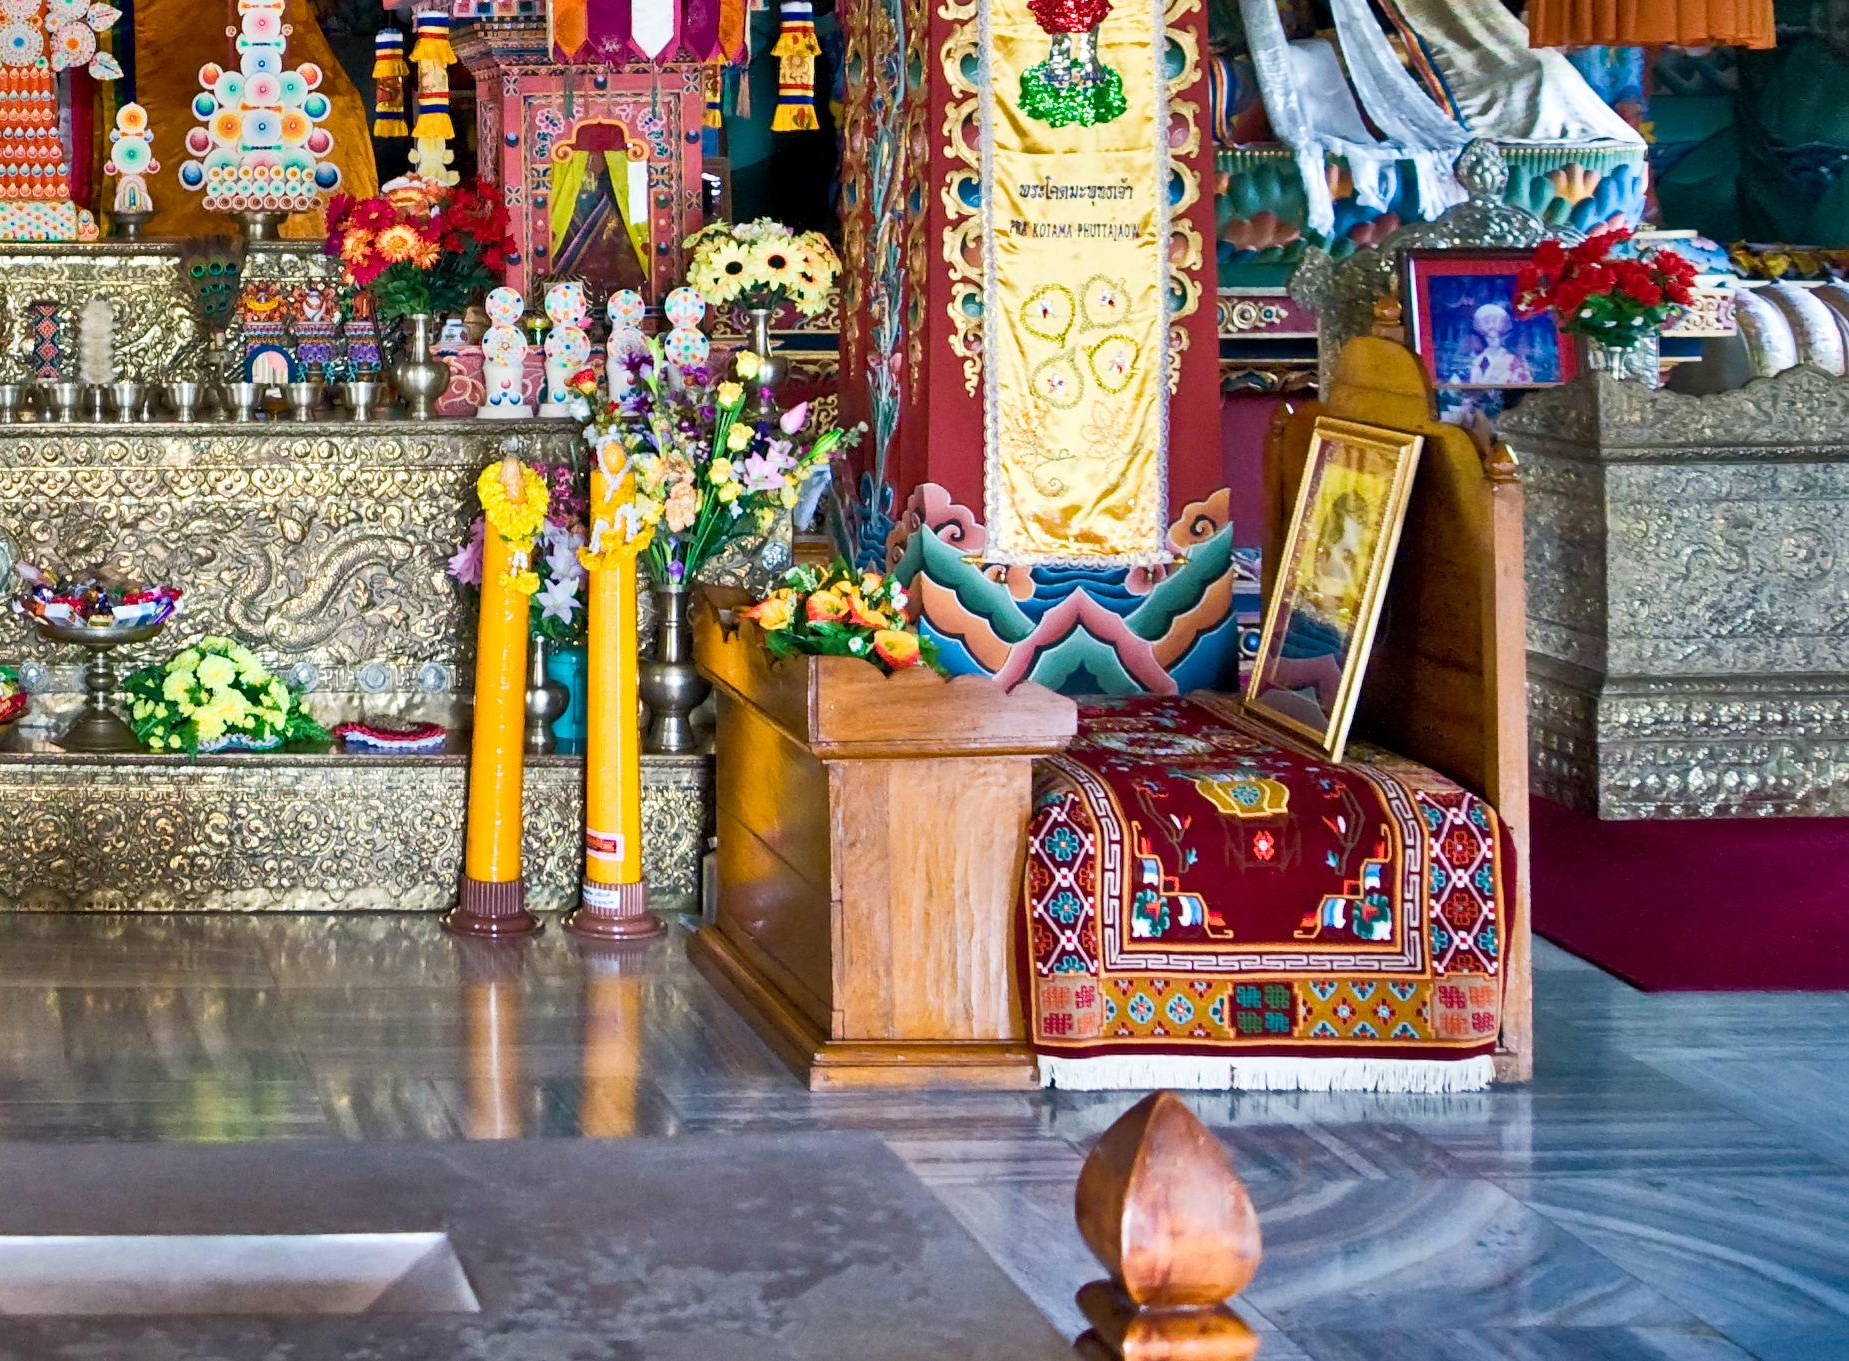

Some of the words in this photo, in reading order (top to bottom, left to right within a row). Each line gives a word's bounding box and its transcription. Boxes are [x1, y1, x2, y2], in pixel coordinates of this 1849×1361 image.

[1010, 220, 1028, 236] PRA
[1032, 223, 1073, 238] KOTAMA
[1077, 223, 1141, 241] PHUTTAJAOW
